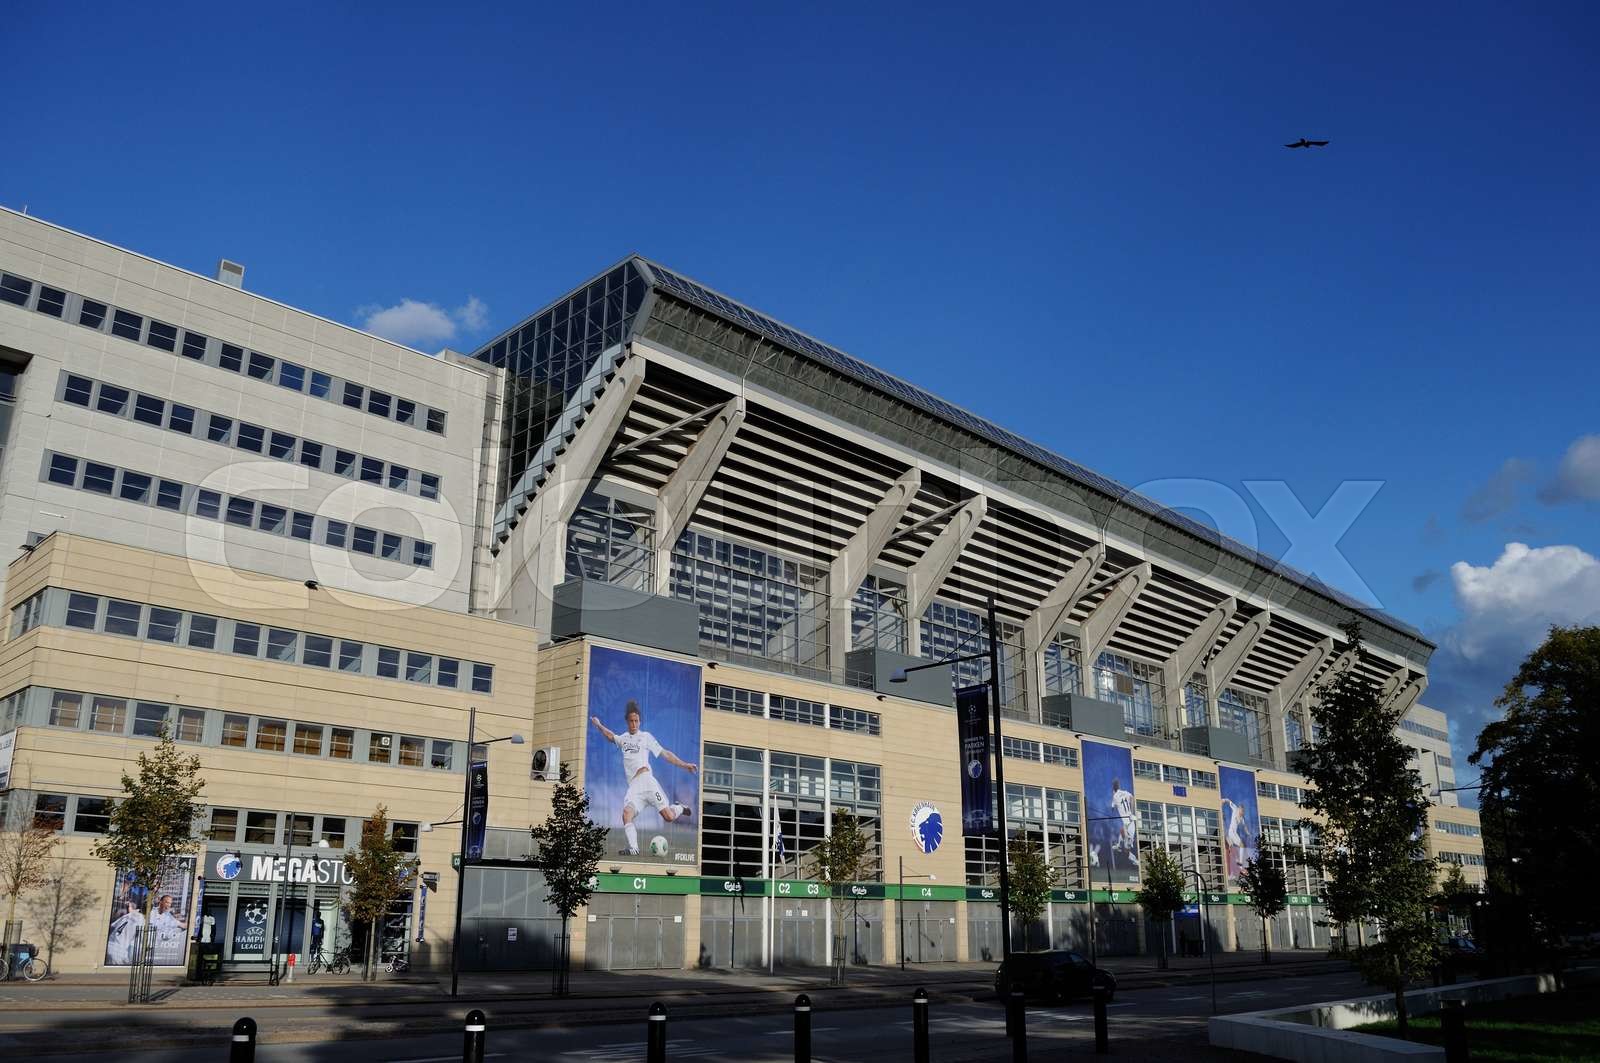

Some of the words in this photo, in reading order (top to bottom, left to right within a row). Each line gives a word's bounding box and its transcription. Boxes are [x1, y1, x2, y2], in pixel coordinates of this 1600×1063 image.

[251, 855, 354, 885] MEGASTO
[633, 878, 647, 890] C1
[778, 883, 791, 894] C2
[807, 883, 819, 895] C3
[921, 888, 932, 897] C4
[235, 935, 279, 944] HAMPIS
